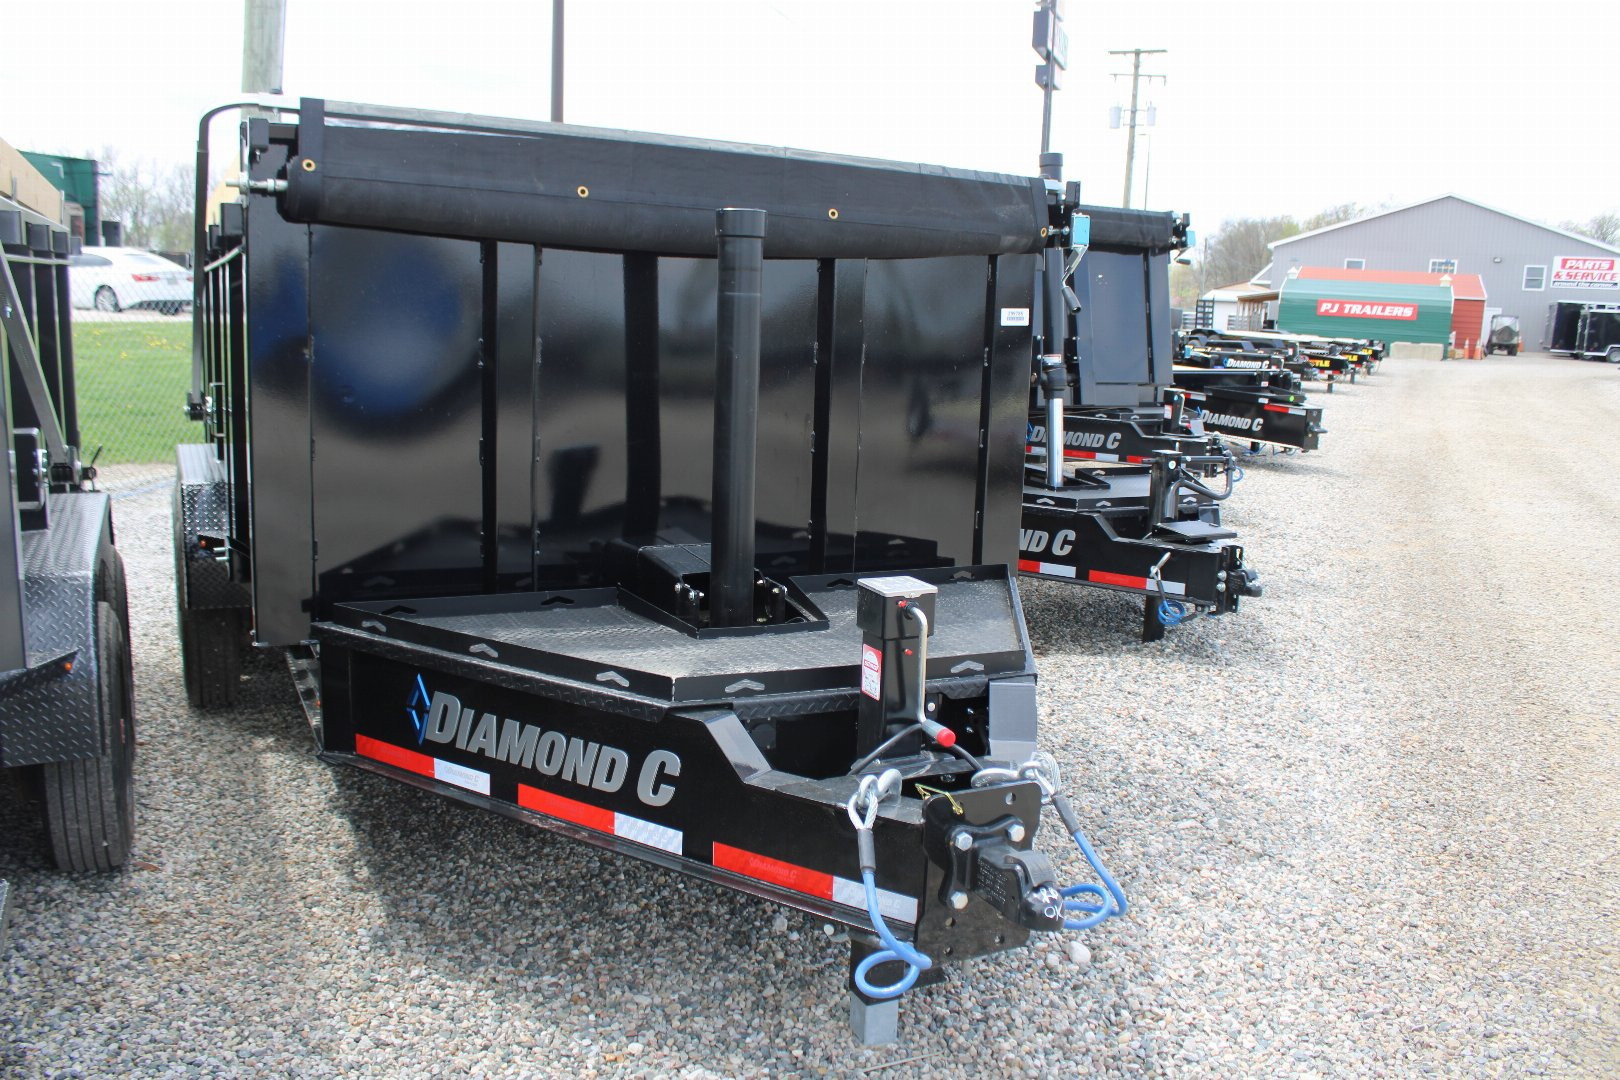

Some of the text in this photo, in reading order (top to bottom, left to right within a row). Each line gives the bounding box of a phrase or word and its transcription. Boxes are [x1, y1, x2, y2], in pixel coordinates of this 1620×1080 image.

[1564, 259, 1611, 270] PARTS
[1553, 271, 1618, 281] & SERVICE
[1320, 302, 1414, 317] PJ TRAILERS
[1226, 358, 1269, 369] DIAMOND C
[1201, 409, 1264, 432] DIAMOND C
[1031, 425, 1122, 449] DIMOND C
[1051, 529, 1076, 556] C
[425, 690, 682, 807] DIAMOND C
